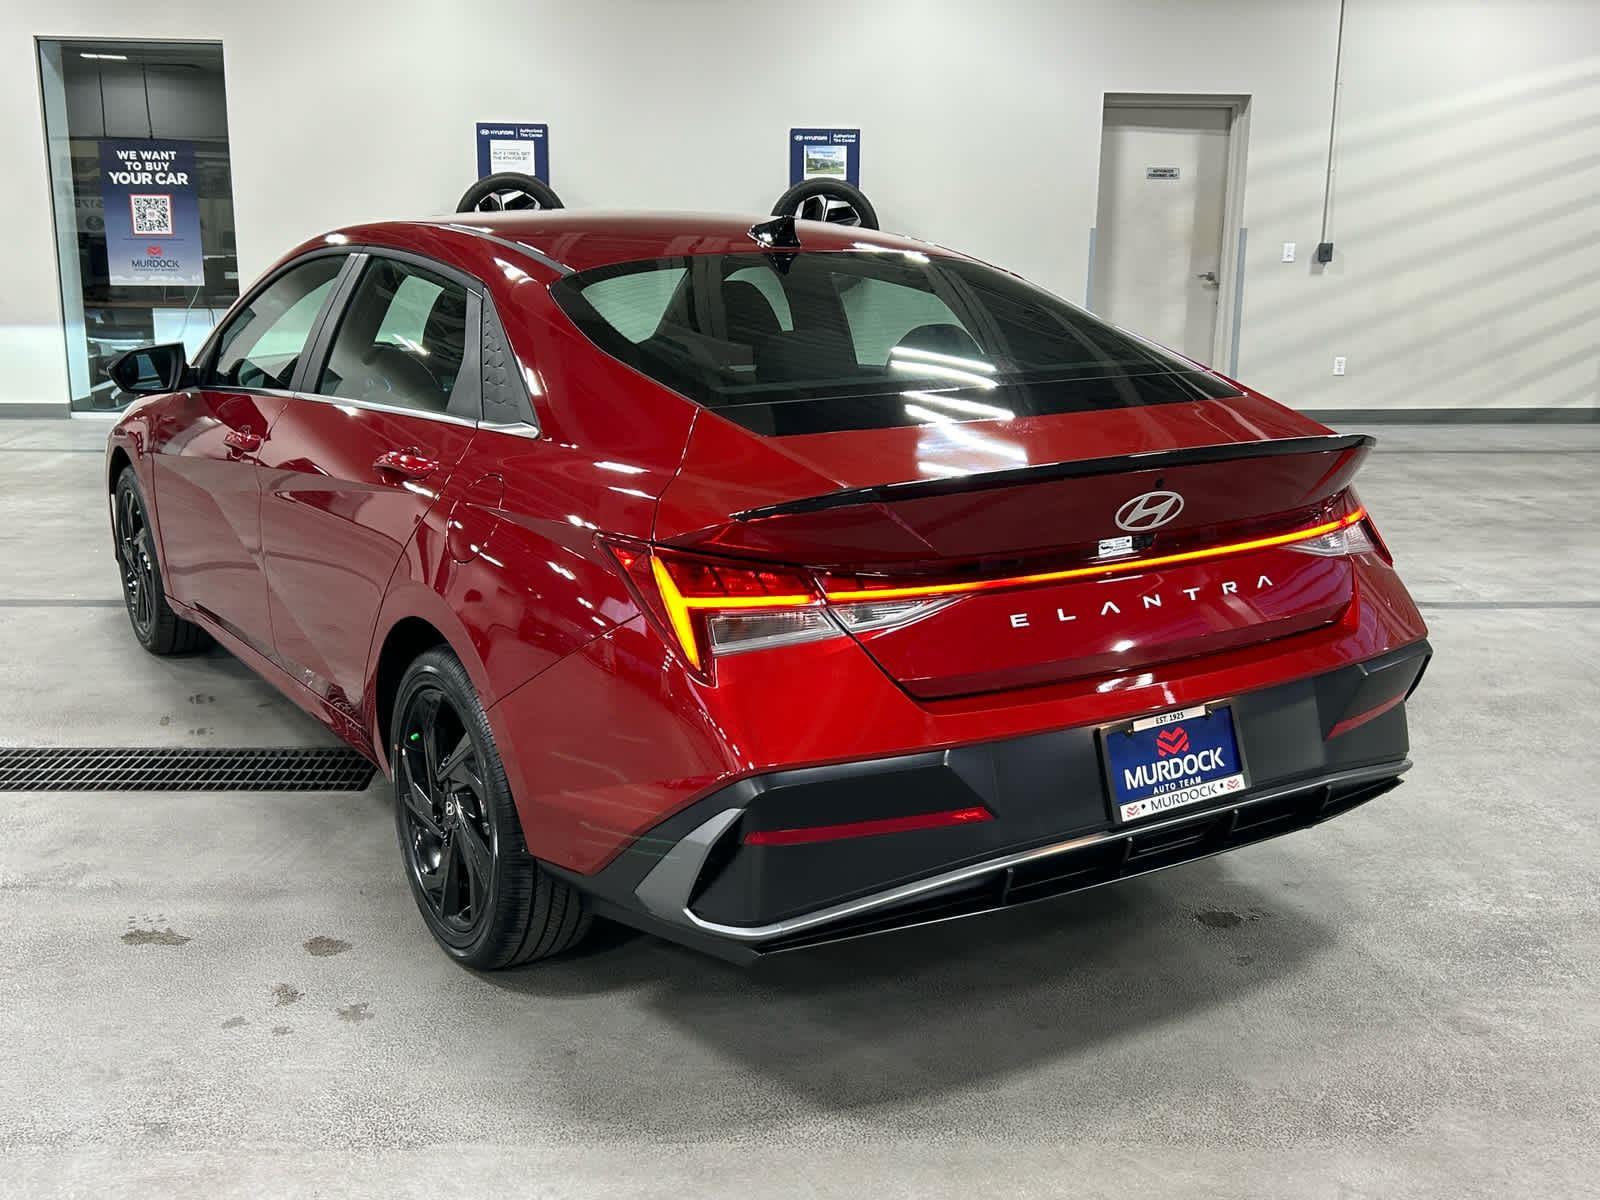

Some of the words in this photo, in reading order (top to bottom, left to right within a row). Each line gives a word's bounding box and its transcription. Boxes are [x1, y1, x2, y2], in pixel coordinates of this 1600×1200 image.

[116, 150, 137, 160] WE
[139, 150, 177, 161] WANT
[125, 161, 142, 171] TO
[145, 161, 170, 171] BUY
[108, 171, 153, 185] YOUR
[155, 172, 189, 185] CAR
[131, 259, 180, 268] MURDOCK
[1009, 575, 1273, 628] ELANTRA
[1155, 715, 1167, 725] EST.
[1169, 711, 1185, 722] 1925
[1124, 747, 1225, 790] MURDOCK
[1153, 782, 1176, 795] AUTO
[1178, 775, 1202, 789] TEAM
[1150, 783, 1218, 811] MURDOCK
